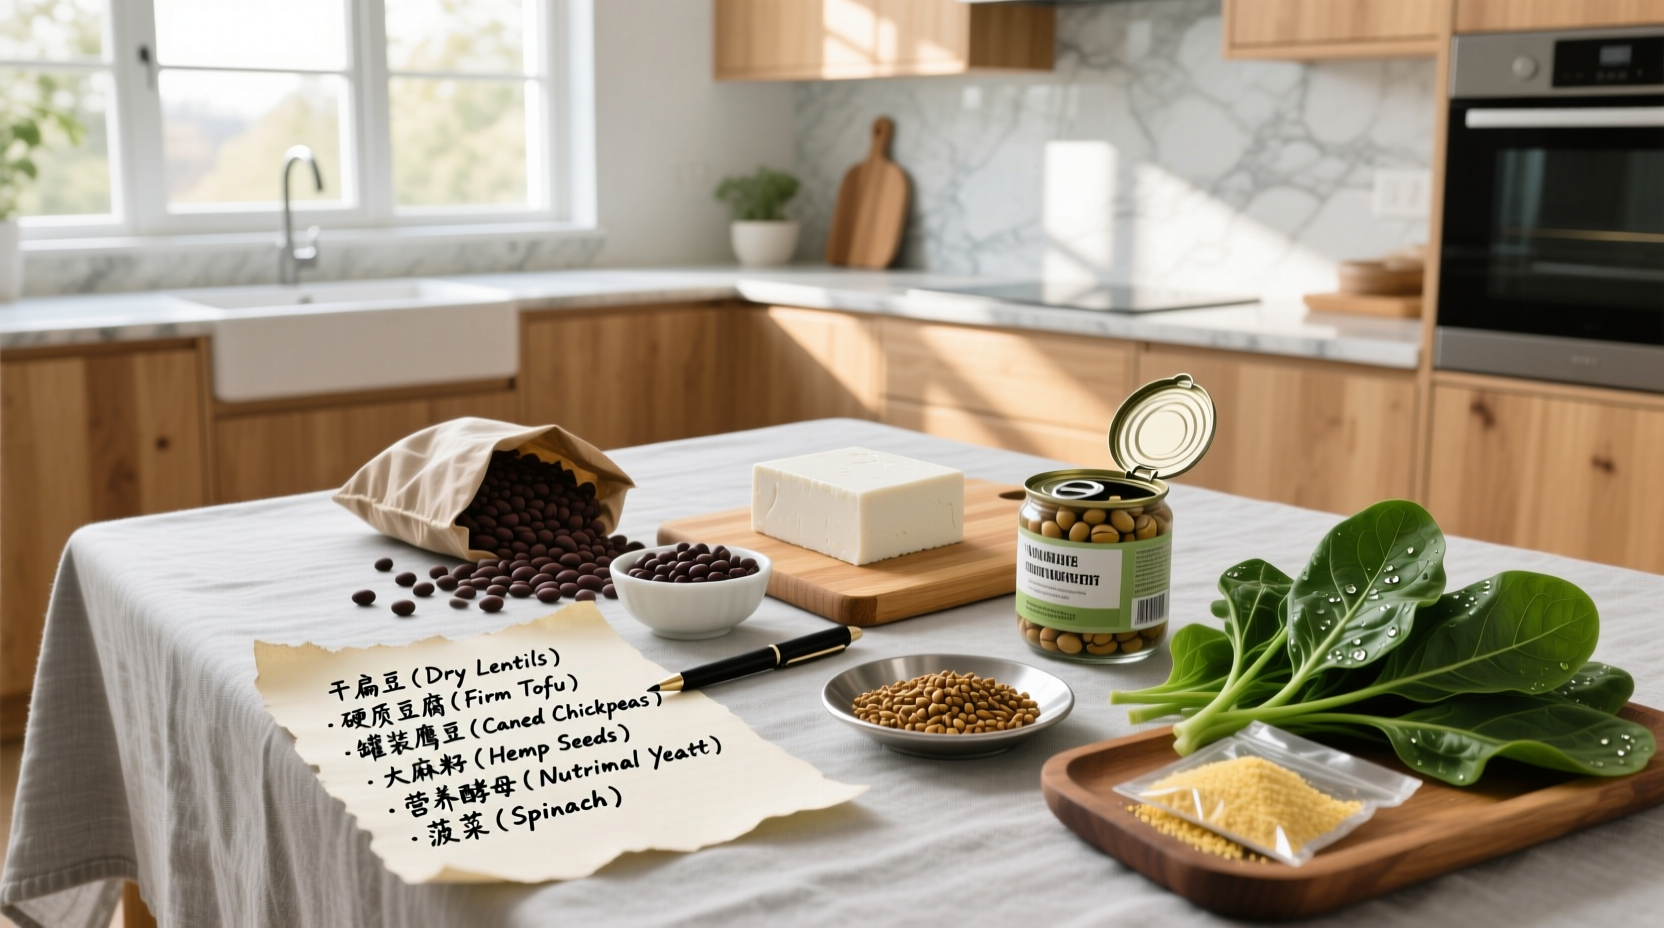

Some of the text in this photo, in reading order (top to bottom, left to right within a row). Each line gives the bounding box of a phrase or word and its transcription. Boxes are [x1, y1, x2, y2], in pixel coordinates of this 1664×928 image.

[476, 647, 560, 677] Lentils)
[516, 673, 578, 701] Tofu)
[552, 692, 663, 722] Chickpeas)
[557, 723, 630, 751] Seeds)
